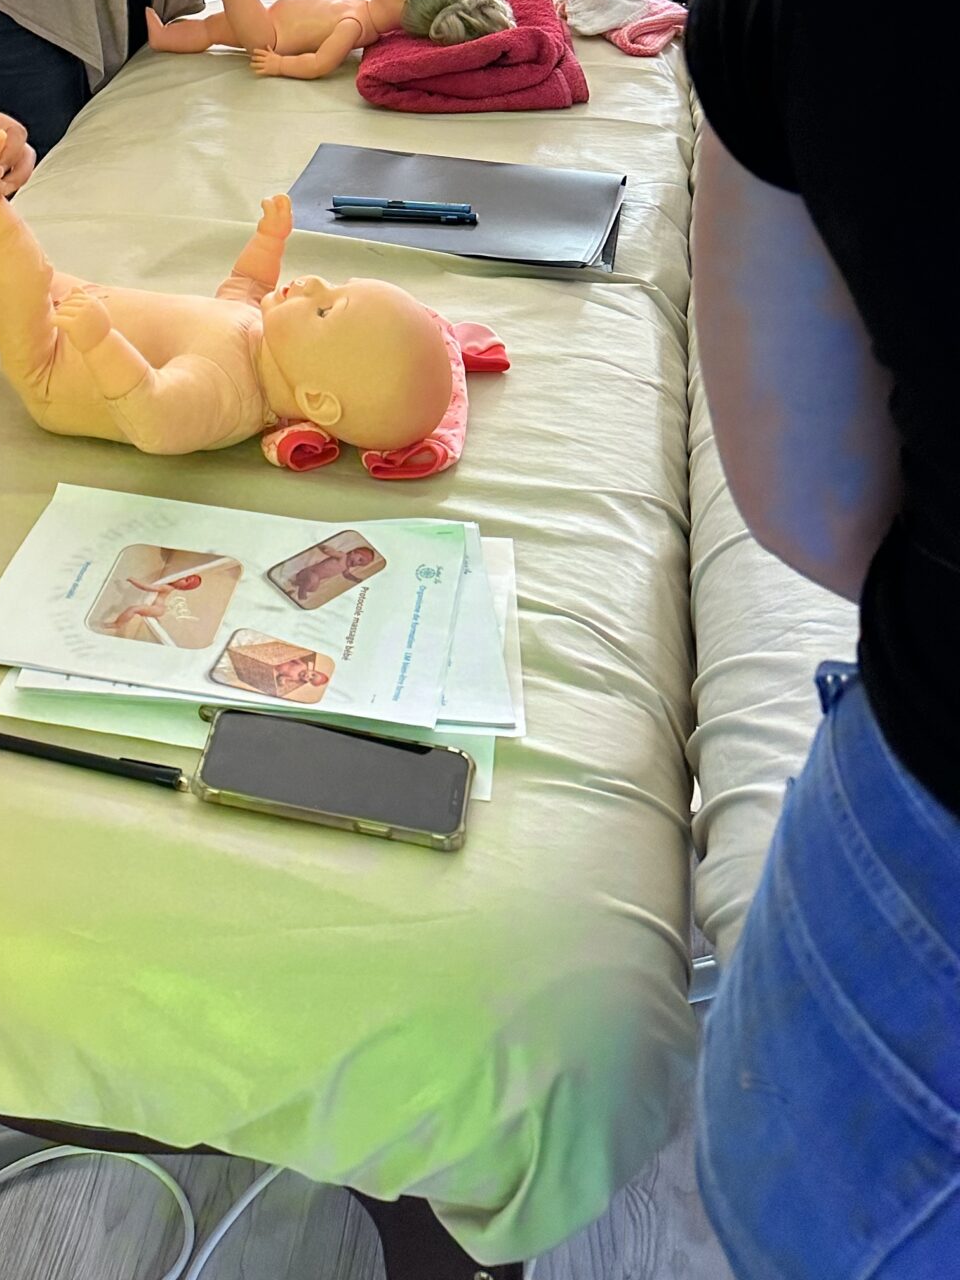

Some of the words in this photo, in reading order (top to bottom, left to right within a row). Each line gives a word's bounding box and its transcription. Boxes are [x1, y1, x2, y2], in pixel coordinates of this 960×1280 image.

[354, 586, 370, 616] Protocole
[345, 617, 360, 645] massage
[342, 646, 354, 661] bébé
